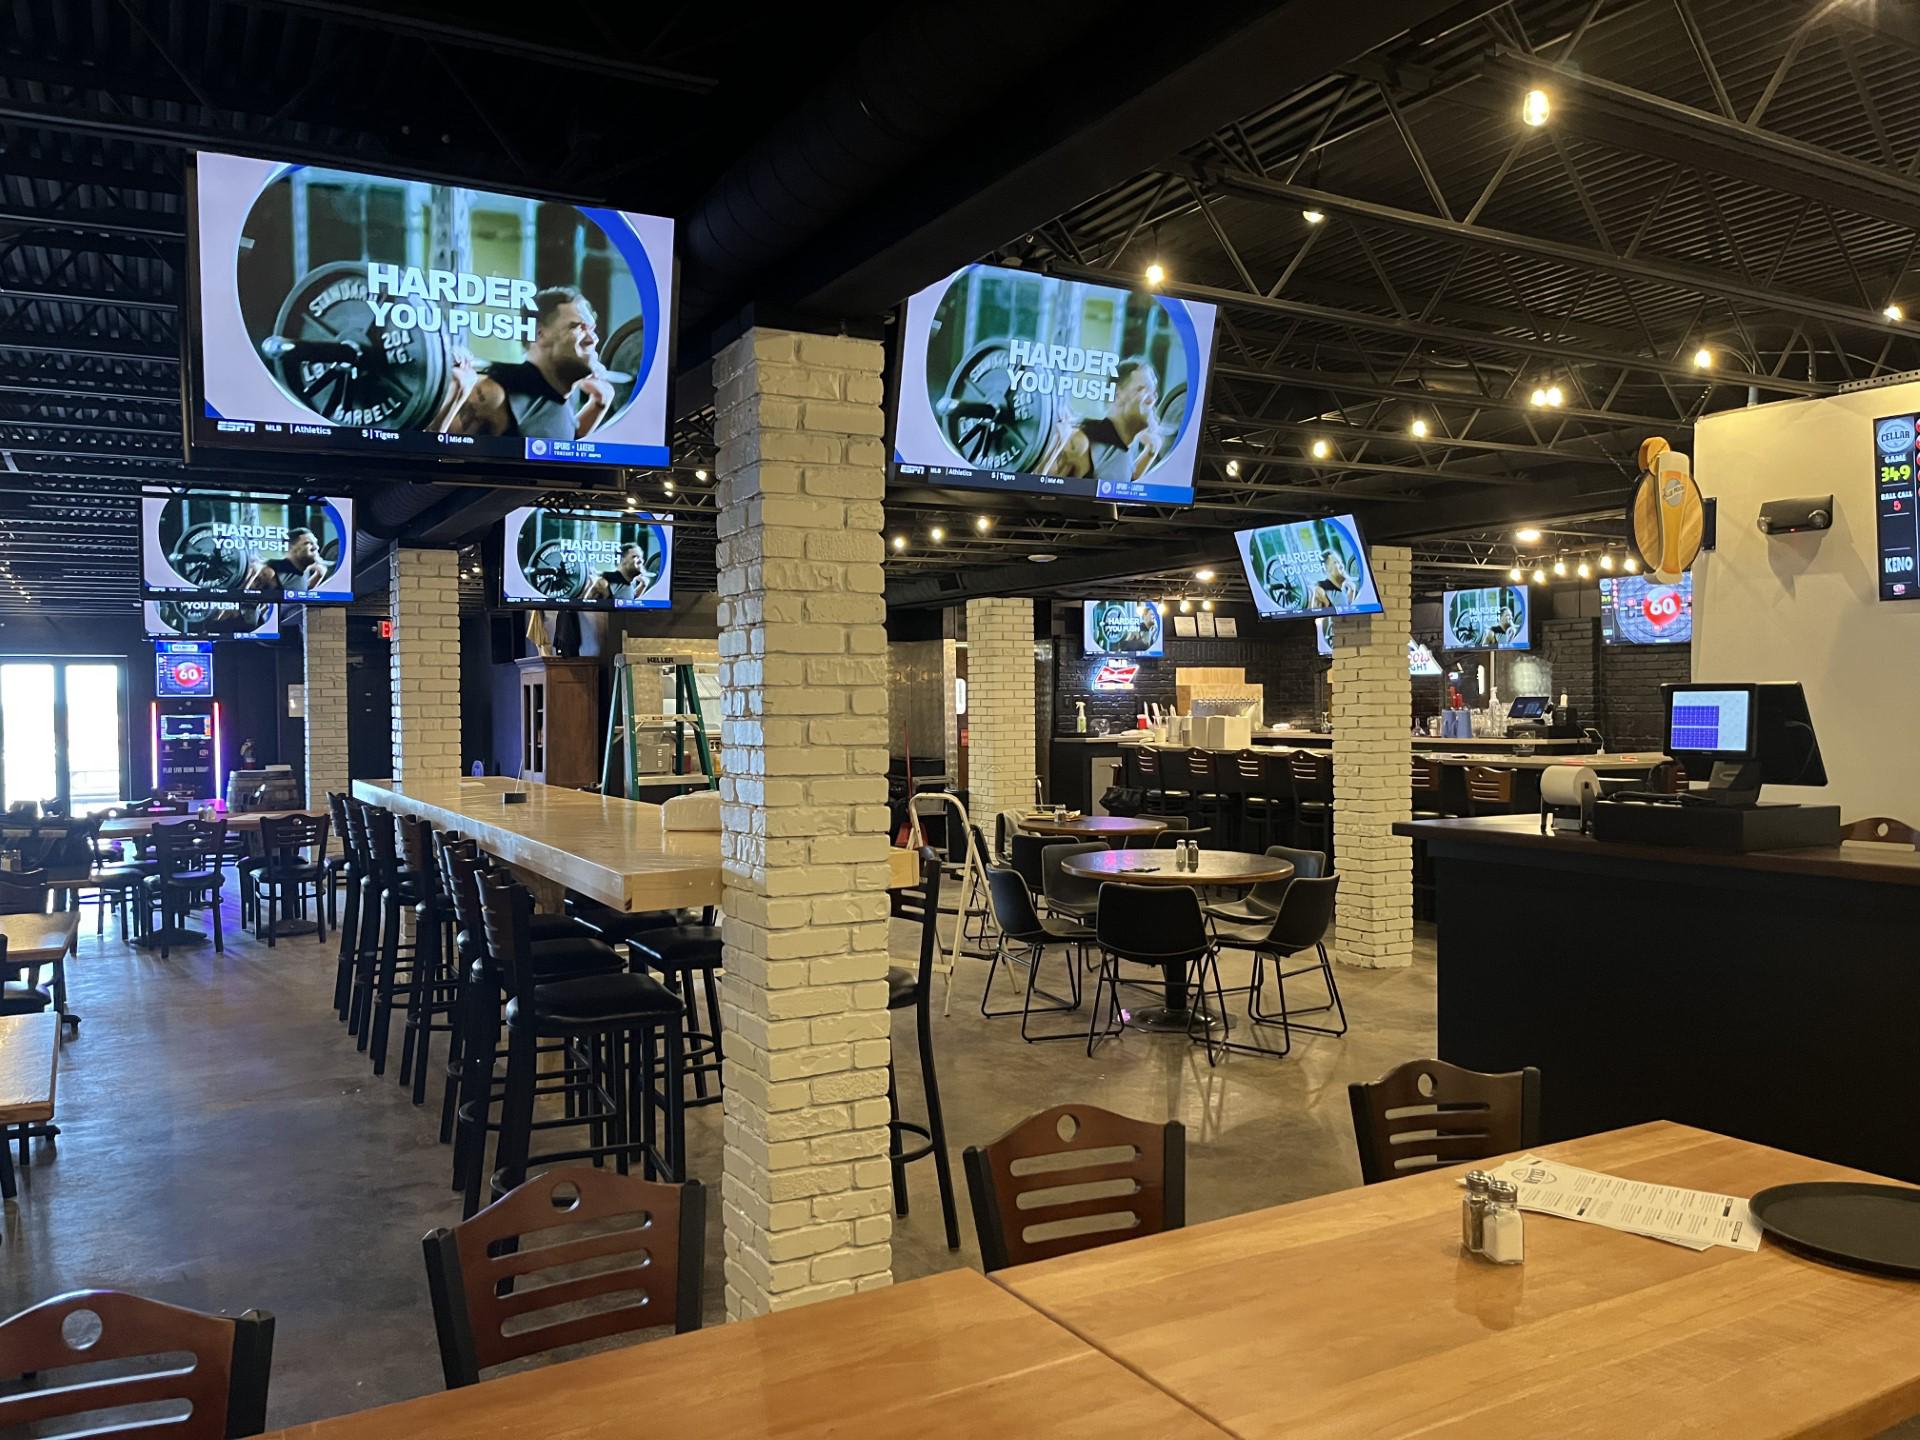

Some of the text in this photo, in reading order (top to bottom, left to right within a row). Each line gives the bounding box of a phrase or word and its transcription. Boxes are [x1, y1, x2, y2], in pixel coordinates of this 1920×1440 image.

[367, 262, 539, 312] HARDER
[367, 301, 537, 342] YOU PUSH
[1009, 339, 1120, 378] HARDER
[1007, 368, 1118, 402] YOU PUSH
[217, 421, 256, 433] ESPN
[294, 425, 332, 436] Athletics
[375, 430, 400, 441] Tigers
[1881, 430, 1911, 443] CELLAR
[1881, 464, 1911, 483] 349
[1897, 490, 1913, 499] CALL
[212, 523, 290, 540] HARDER
[212, 537, 289, 552] YOU PUSH
[560, 538, 622, 553] HARDER
[560, 551, 621, 564] YOU PUSH
[1278, 549, 1325, 565] HARDER
[1885, 556, 1914, 574] KENO
[187, 601, 240, 611] YOU PUSH
[1649, 597, 1677, 616] 60
[647, 656, 674, 664] KELLER
[178, 668, 200, 681] 60
